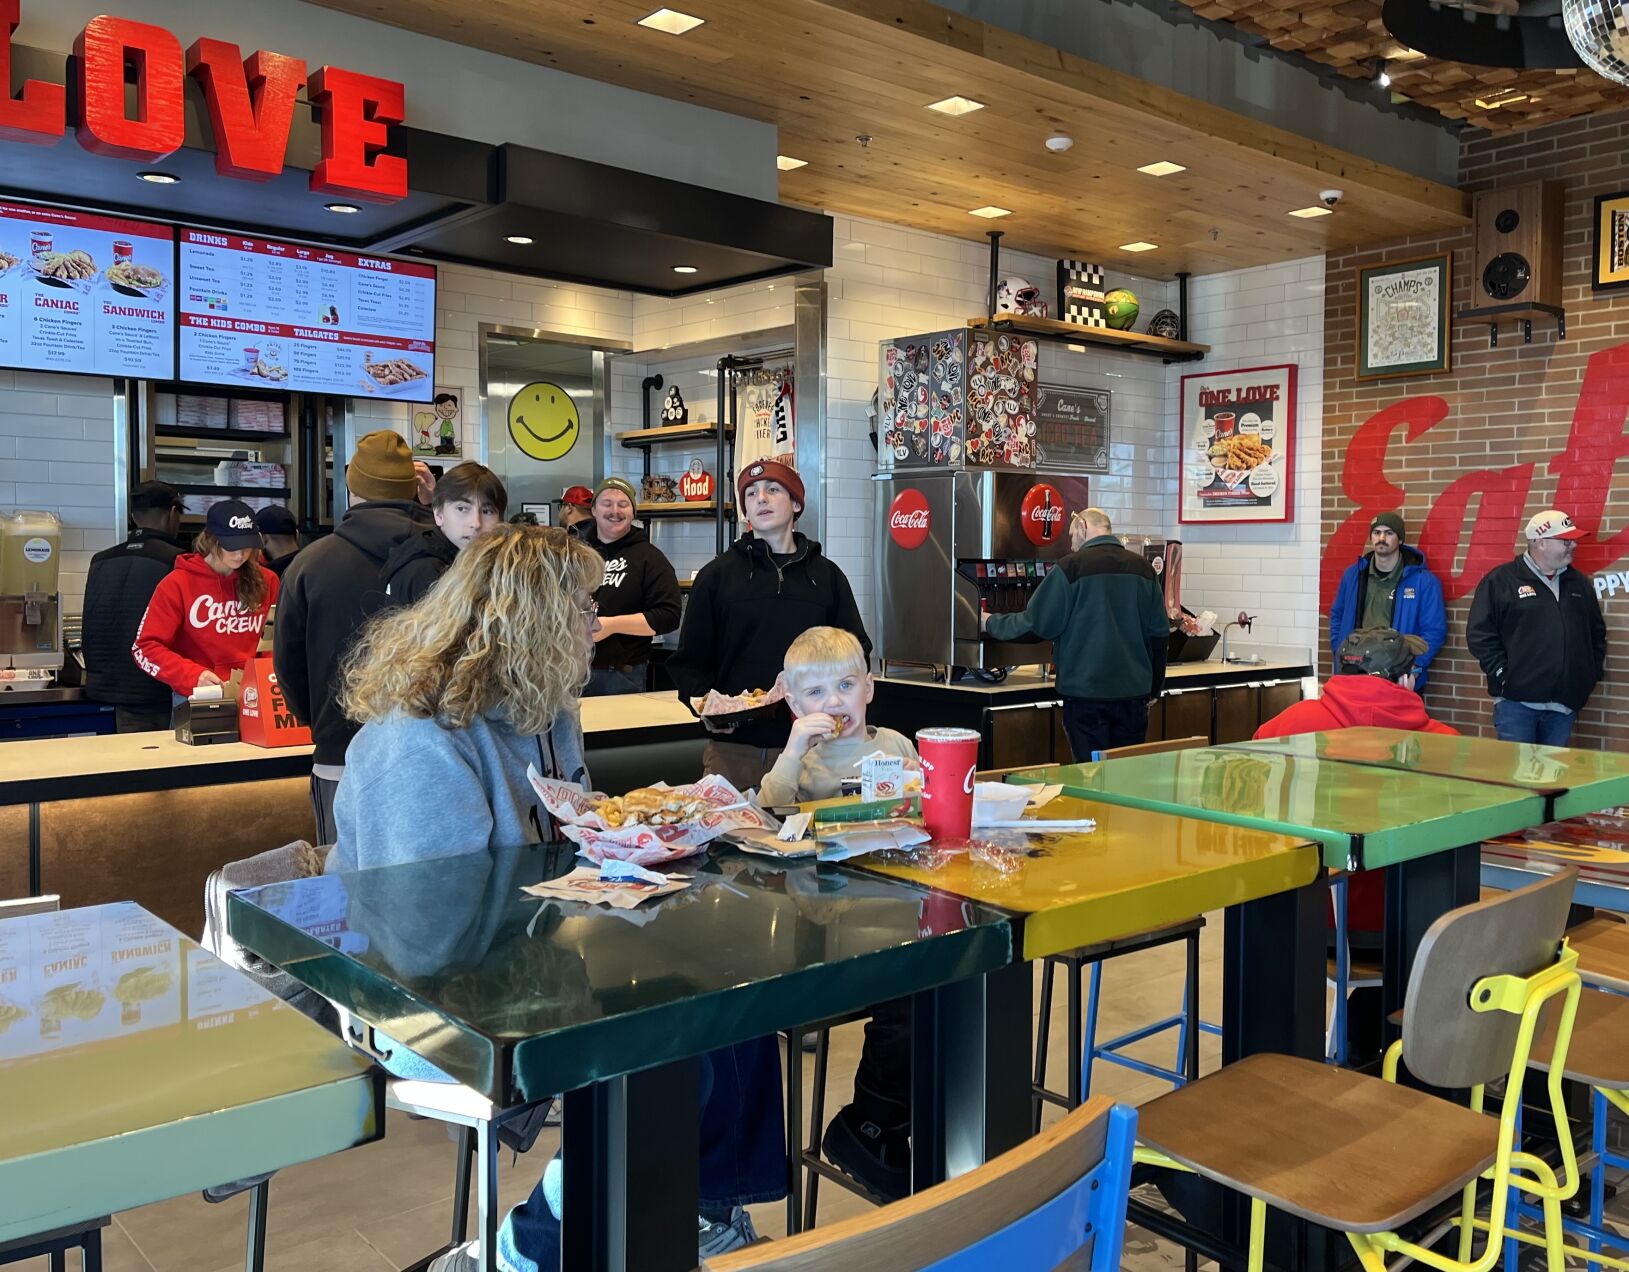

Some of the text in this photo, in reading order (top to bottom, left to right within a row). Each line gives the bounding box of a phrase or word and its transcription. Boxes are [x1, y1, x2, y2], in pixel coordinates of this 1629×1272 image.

[0, 0, 408, 204] LOVE
[189, 232, 228, 246] DRINKS
[266, 244, 286, 252] Regular
[296, 248, 310, 256] Large
[1617, 214, 1625, 267] BOSTON
[189, 248, 215, 257] Lemonade
[189, 263, 206, 271] Sweet
[358, 257, 392, 271] EXTRAS
[189, 275, 211, 283] Unsweet
[189, 287, 211, 295] Fountain
[1384, 279, 1423, 298] CHAMPS
[34, 297, 79, 311] CANIAC
[103, 305, 165, 320] SANDWICH
[39, 317, 60, 325] Chicken
[189, 316, 208, 326] THE
[210, 318, 232, 329] KIDS
[234, 320, 266, 333] COMBO
[198, 332, 217, 340] Chicken
[293, 328, 339, 341] TAILGATES
[1199, 384, 1281, 408] ONE LOVE
[1007, 402, 1017, 411] 1LV
[1057, 398, 1080, 414] Cane's
[683, 477, 709, 497] Hood
[1319, 342, 1629, 618] Eat
[890, 509, 930, 530] Coca-Cola
[1031, 505, 1063, 522] Coca-Cola
[1535, 521, 1552, 536] 1LV
[601, 572, 626, 588] EW
[1593, 570, 1629, 600] PPY
[215, 615, 262, 635] CREW
[134, 649, 161, 677] CANE'S
[875, 759, 901, 767] Honest
